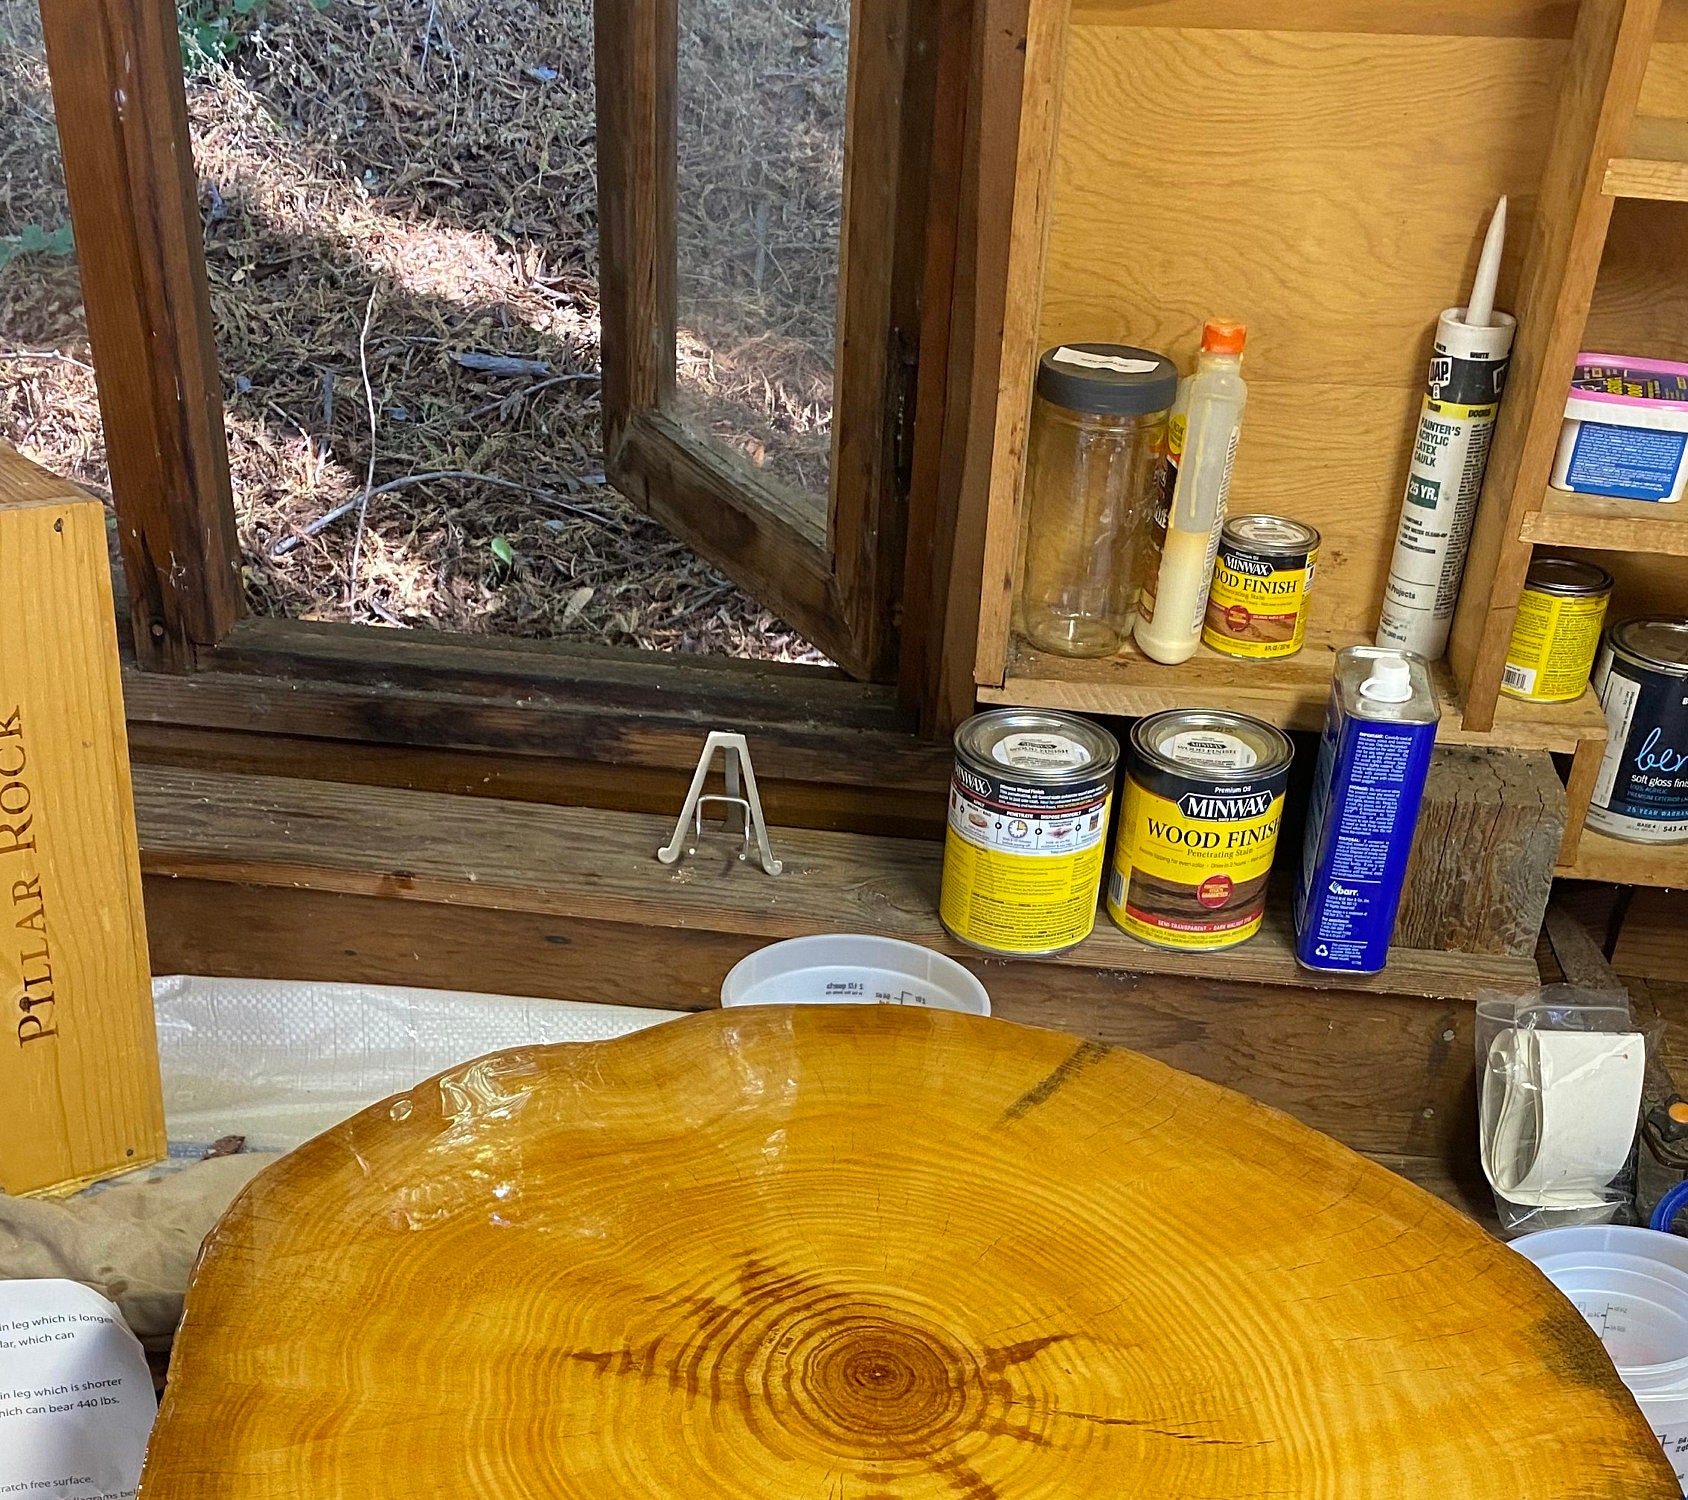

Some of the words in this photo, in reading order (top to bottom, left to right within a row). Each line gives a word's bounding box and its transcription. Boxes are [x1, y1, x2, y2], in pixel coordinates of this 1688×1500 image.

[1420, 417, 1461, 436] PAINTER'S
[1419, 429, 1449, 446] ACRYLIC
[1416, 439, 1437, 456] LATEX
[1414, 451, 1436, 468] CAULK
[1409, 481, 1418, 496] 25
[1225, 555, 1270, 576] MINWAX
[1214, 566, 1240, 588] OOD
[1243, 578, 1298, 595] FINISH
[1391, 584, 1415, 600] Projects
[0, 704, 37, 854] ROCK
[1631, 774, 1648, 785] soft
[1648, 776, 1672, 788] gloss
[1214, 786, 1242, 794] Premium
[1186, 794, 1268, 819] MINWAX
[1147, 816, 1221, 849] WOOD
[1225, 817, 1281, 849] FINISH
[1187, 849, 1234, 860] Penetrating
[1235, 848, 1254, 857] Stain
[12, 873, 60, 1048] PILLAR
[12, 1321, 29, 1330] leg
[32, 1314, 65, 1326] which
[68, 1314, 77, 1322] is
[79, 1313, 114, 1324] longer
[18, 1333, 52, 1347] which
[54, 1331, 75, 1341] can
[13, 1389, 31, 1399] leg
[34, 1385, 68, 1397] which
[70, 1384, 80, 1392] is
[82, 1378, 122, 1391] shorter
[25, 1406, 46, 1414] can
[49, 1402, 74, 1413] bear
[76, 1398, 98, 1408] 440
[100, 1396, 120, 1406] lbs.
[0, 1482, 28, 1493] ratch
[30, 1480, 51, 1492] free
[53, 1475, 94, 1487] surface.
